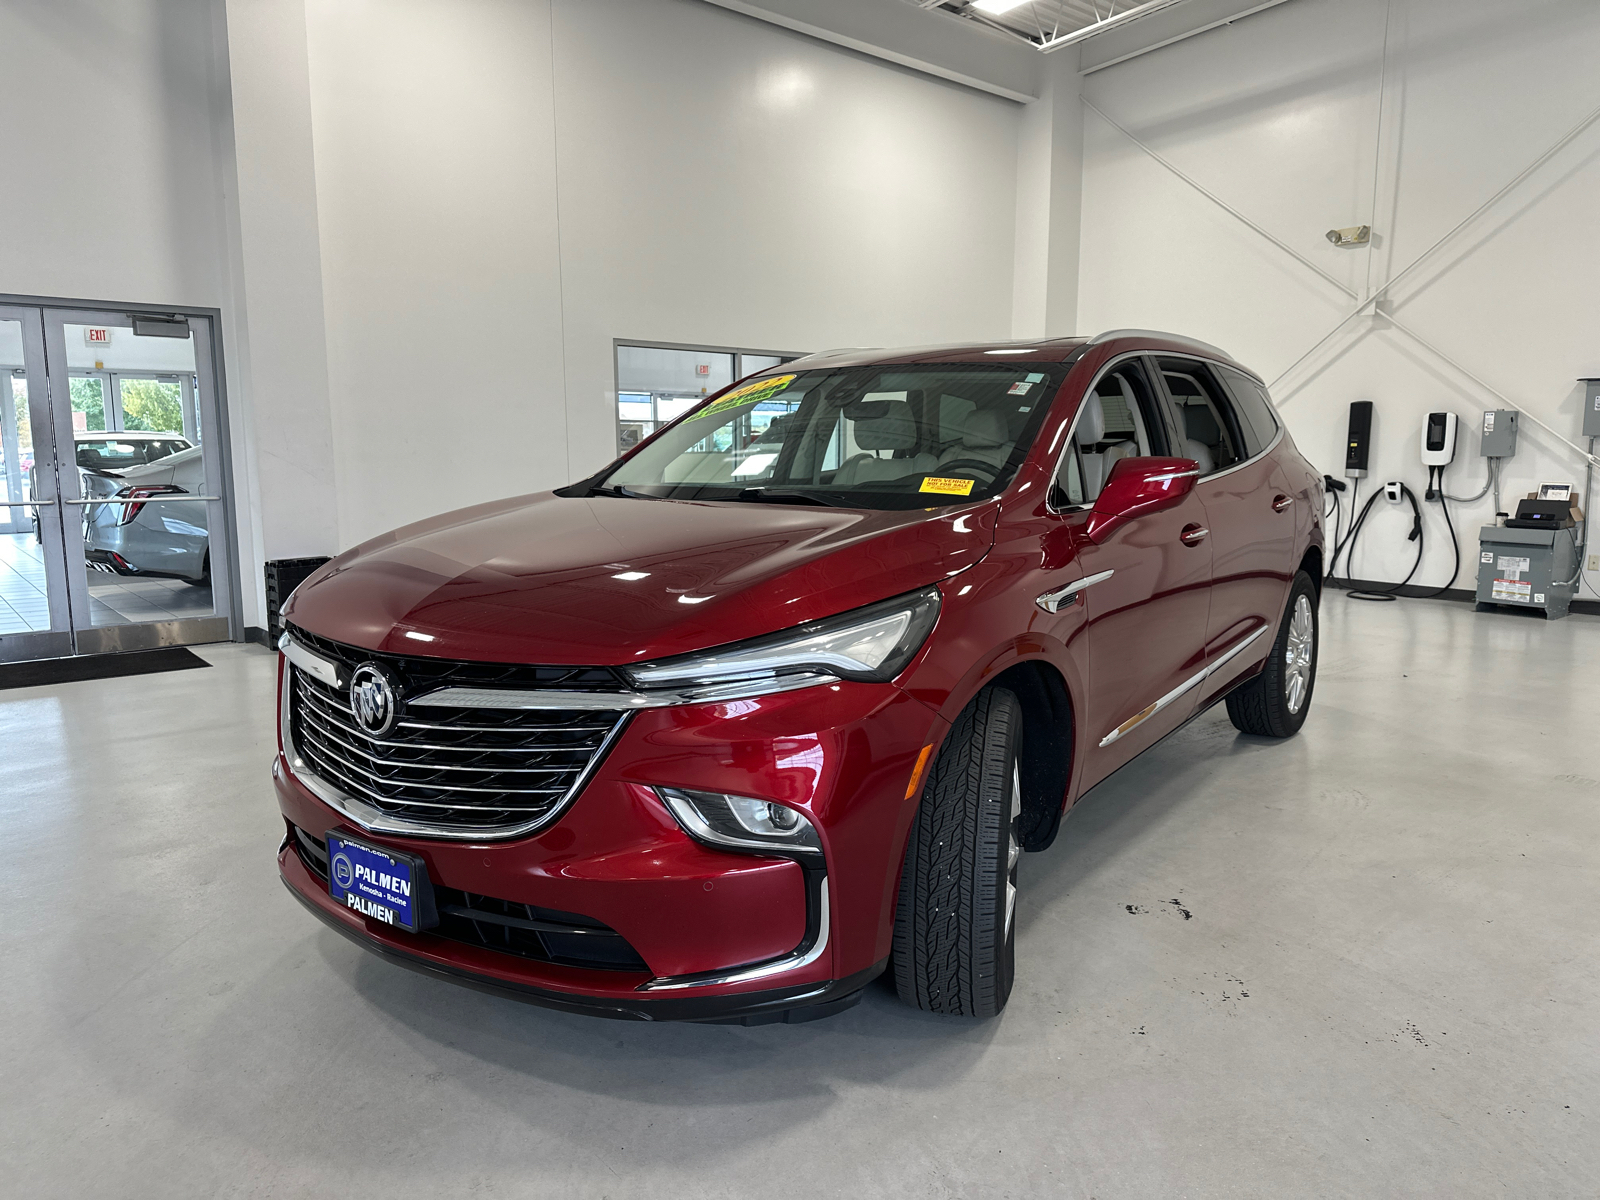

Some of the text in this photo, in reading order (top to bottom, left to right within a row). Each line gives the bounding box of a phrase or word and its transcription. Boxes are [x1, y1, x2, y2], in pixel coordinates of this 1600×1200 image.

[89, 329, 107, 341] EXIT
[343, 839, 390, 860] palmen.com
[355, 863, 411, 897] PALMEN
[359, 882, 383, 898] Kenosha
[386, 893, 407, 907] Racine
[347, 893, 394, 925] PALMEN
